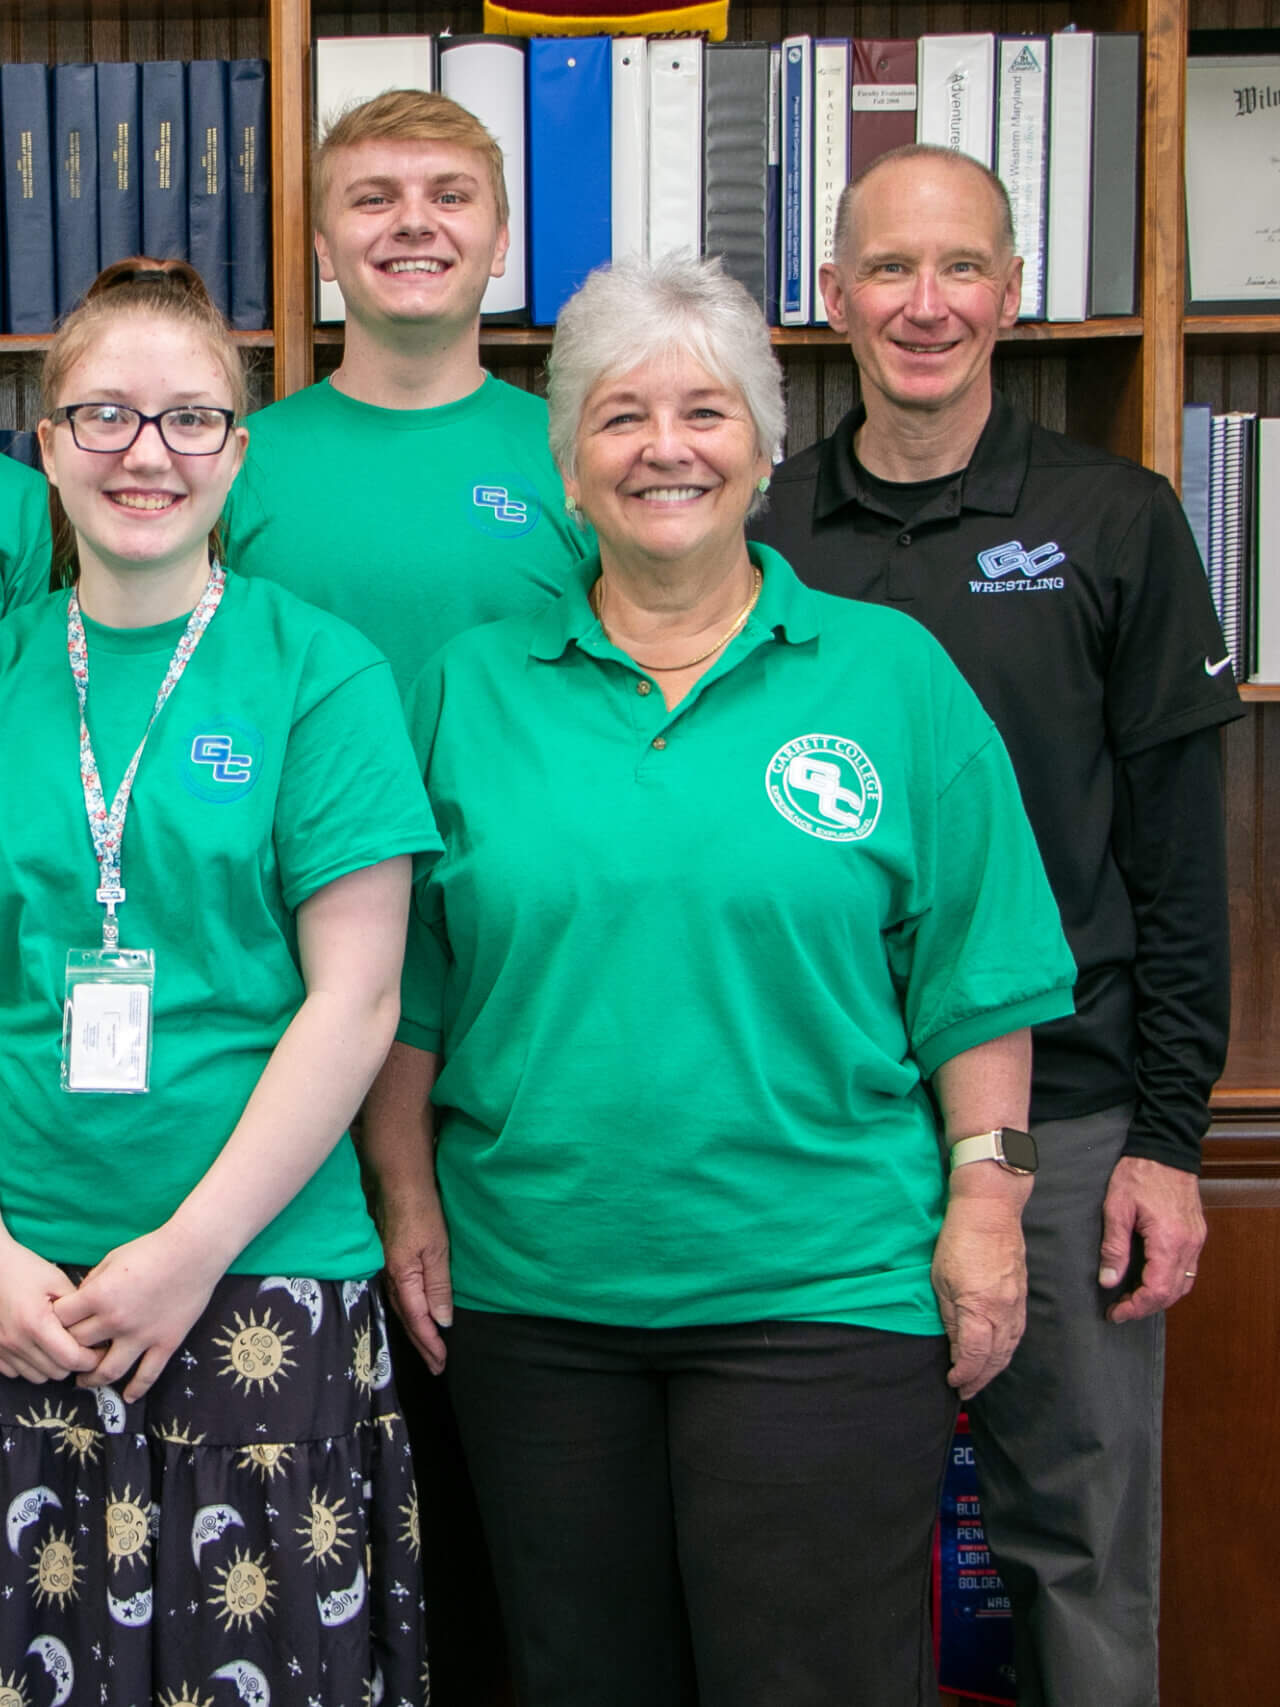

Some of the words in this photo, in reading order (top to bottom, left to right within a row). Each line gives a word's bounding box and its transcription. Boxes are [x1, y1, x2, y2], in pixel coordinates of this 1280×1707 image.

[950, 73, 965, 152] Adventures
[1011, 76, 1023, 127] Maryland
[824, 182, 833, 259] HANDBOO
[473, 485, 527, 523] GC
[977, 540, 1066, 579] GC
[968, 577, 1065, 593] WRESTLING
[190, 735, 252, 783] GC
[771, 737, 830, 774] GARRETT
[835, 741, 879, 801] COLLEGE
[957, 1551, 992, 1566] LIGHT
